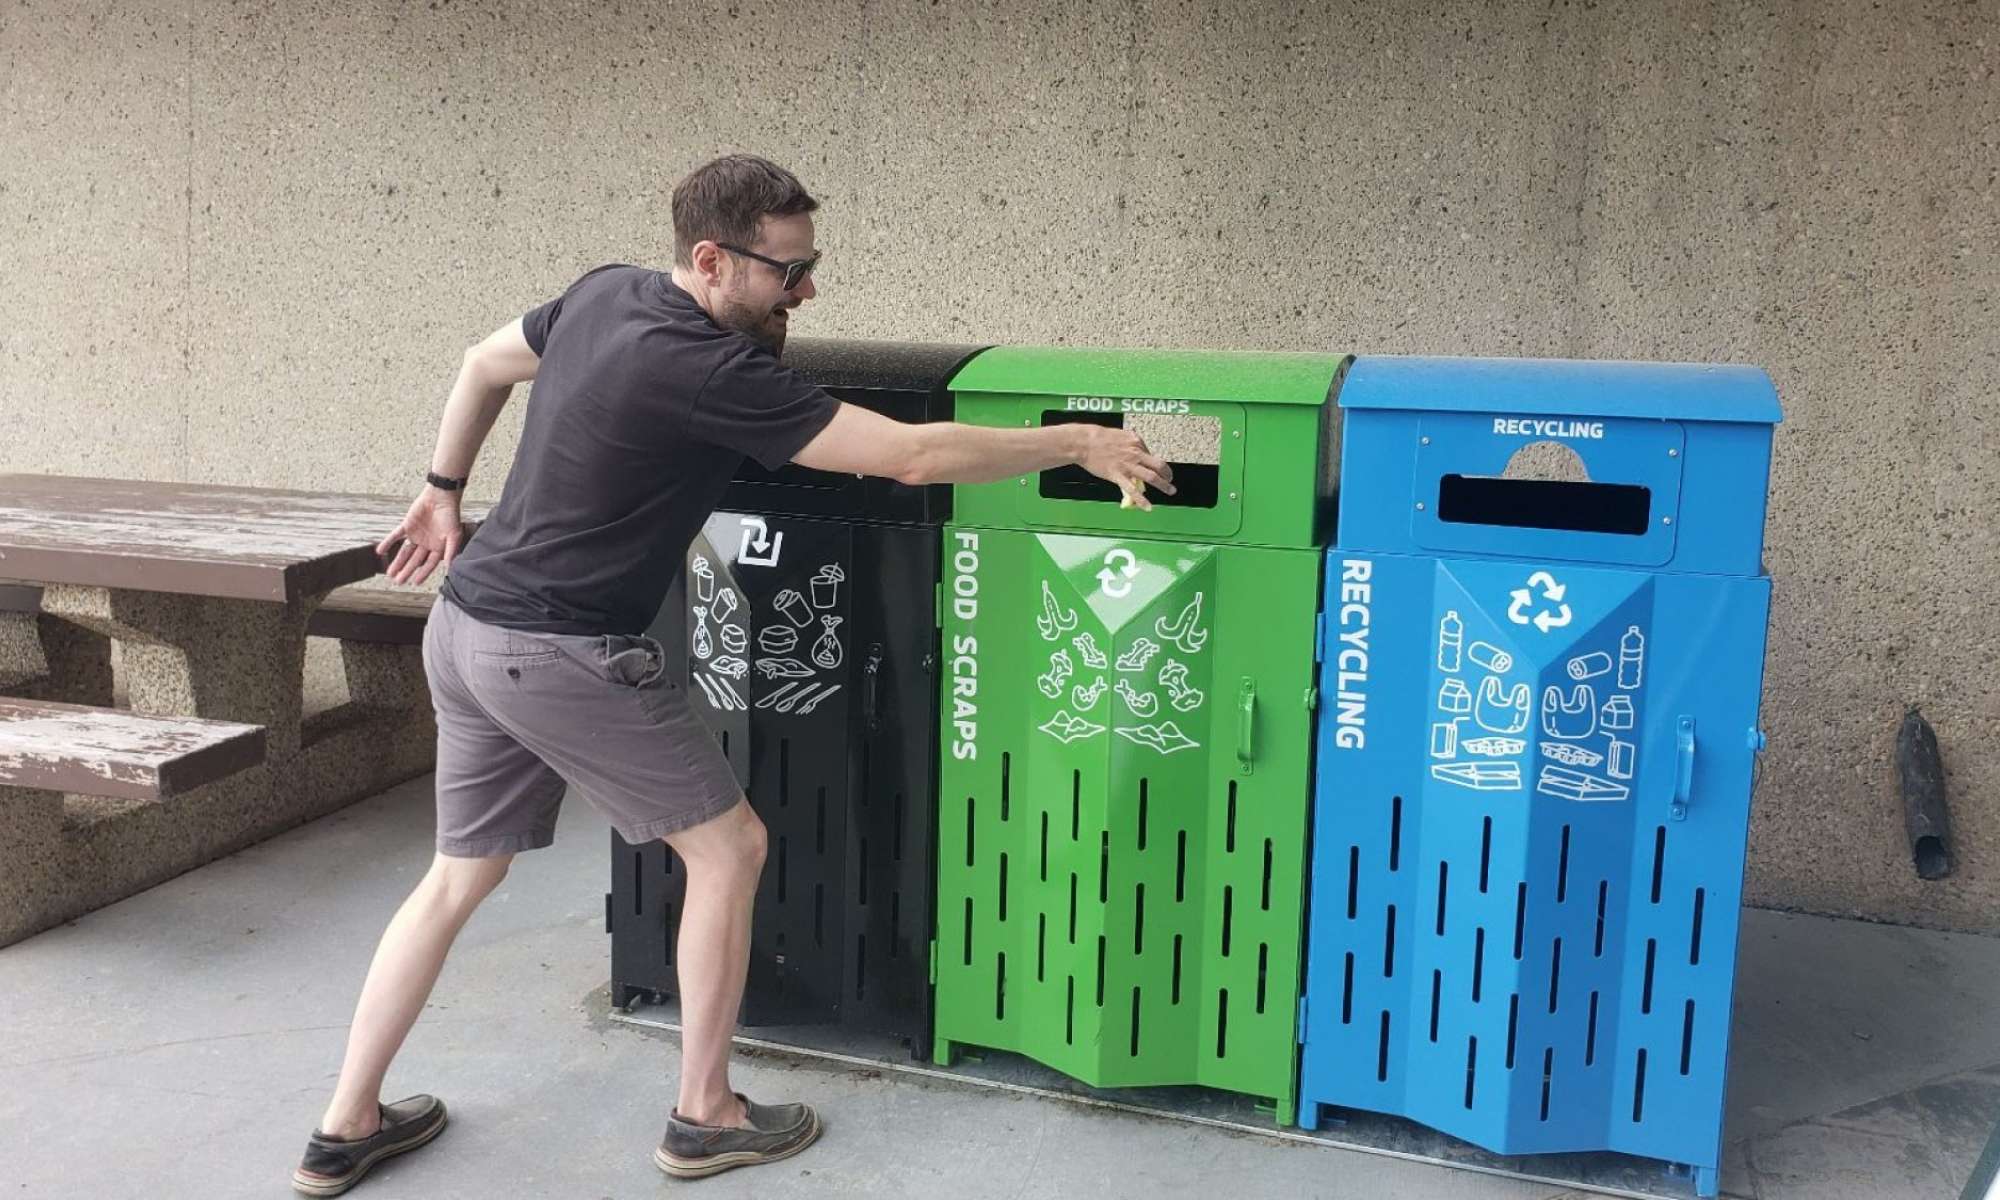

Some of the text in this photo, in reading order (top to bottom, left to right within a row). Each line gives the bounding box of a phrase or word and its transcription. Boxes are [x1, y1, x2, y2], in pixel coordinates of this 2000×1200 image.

[1067, 397, 1190, 413] FOOD SCRAPS
[1493, 418, 1604, 439] RECYCLING
[952, 532, 979, 761] FOOD SCRAPS
[1336, 560, 1372, 749] RECYCLING
